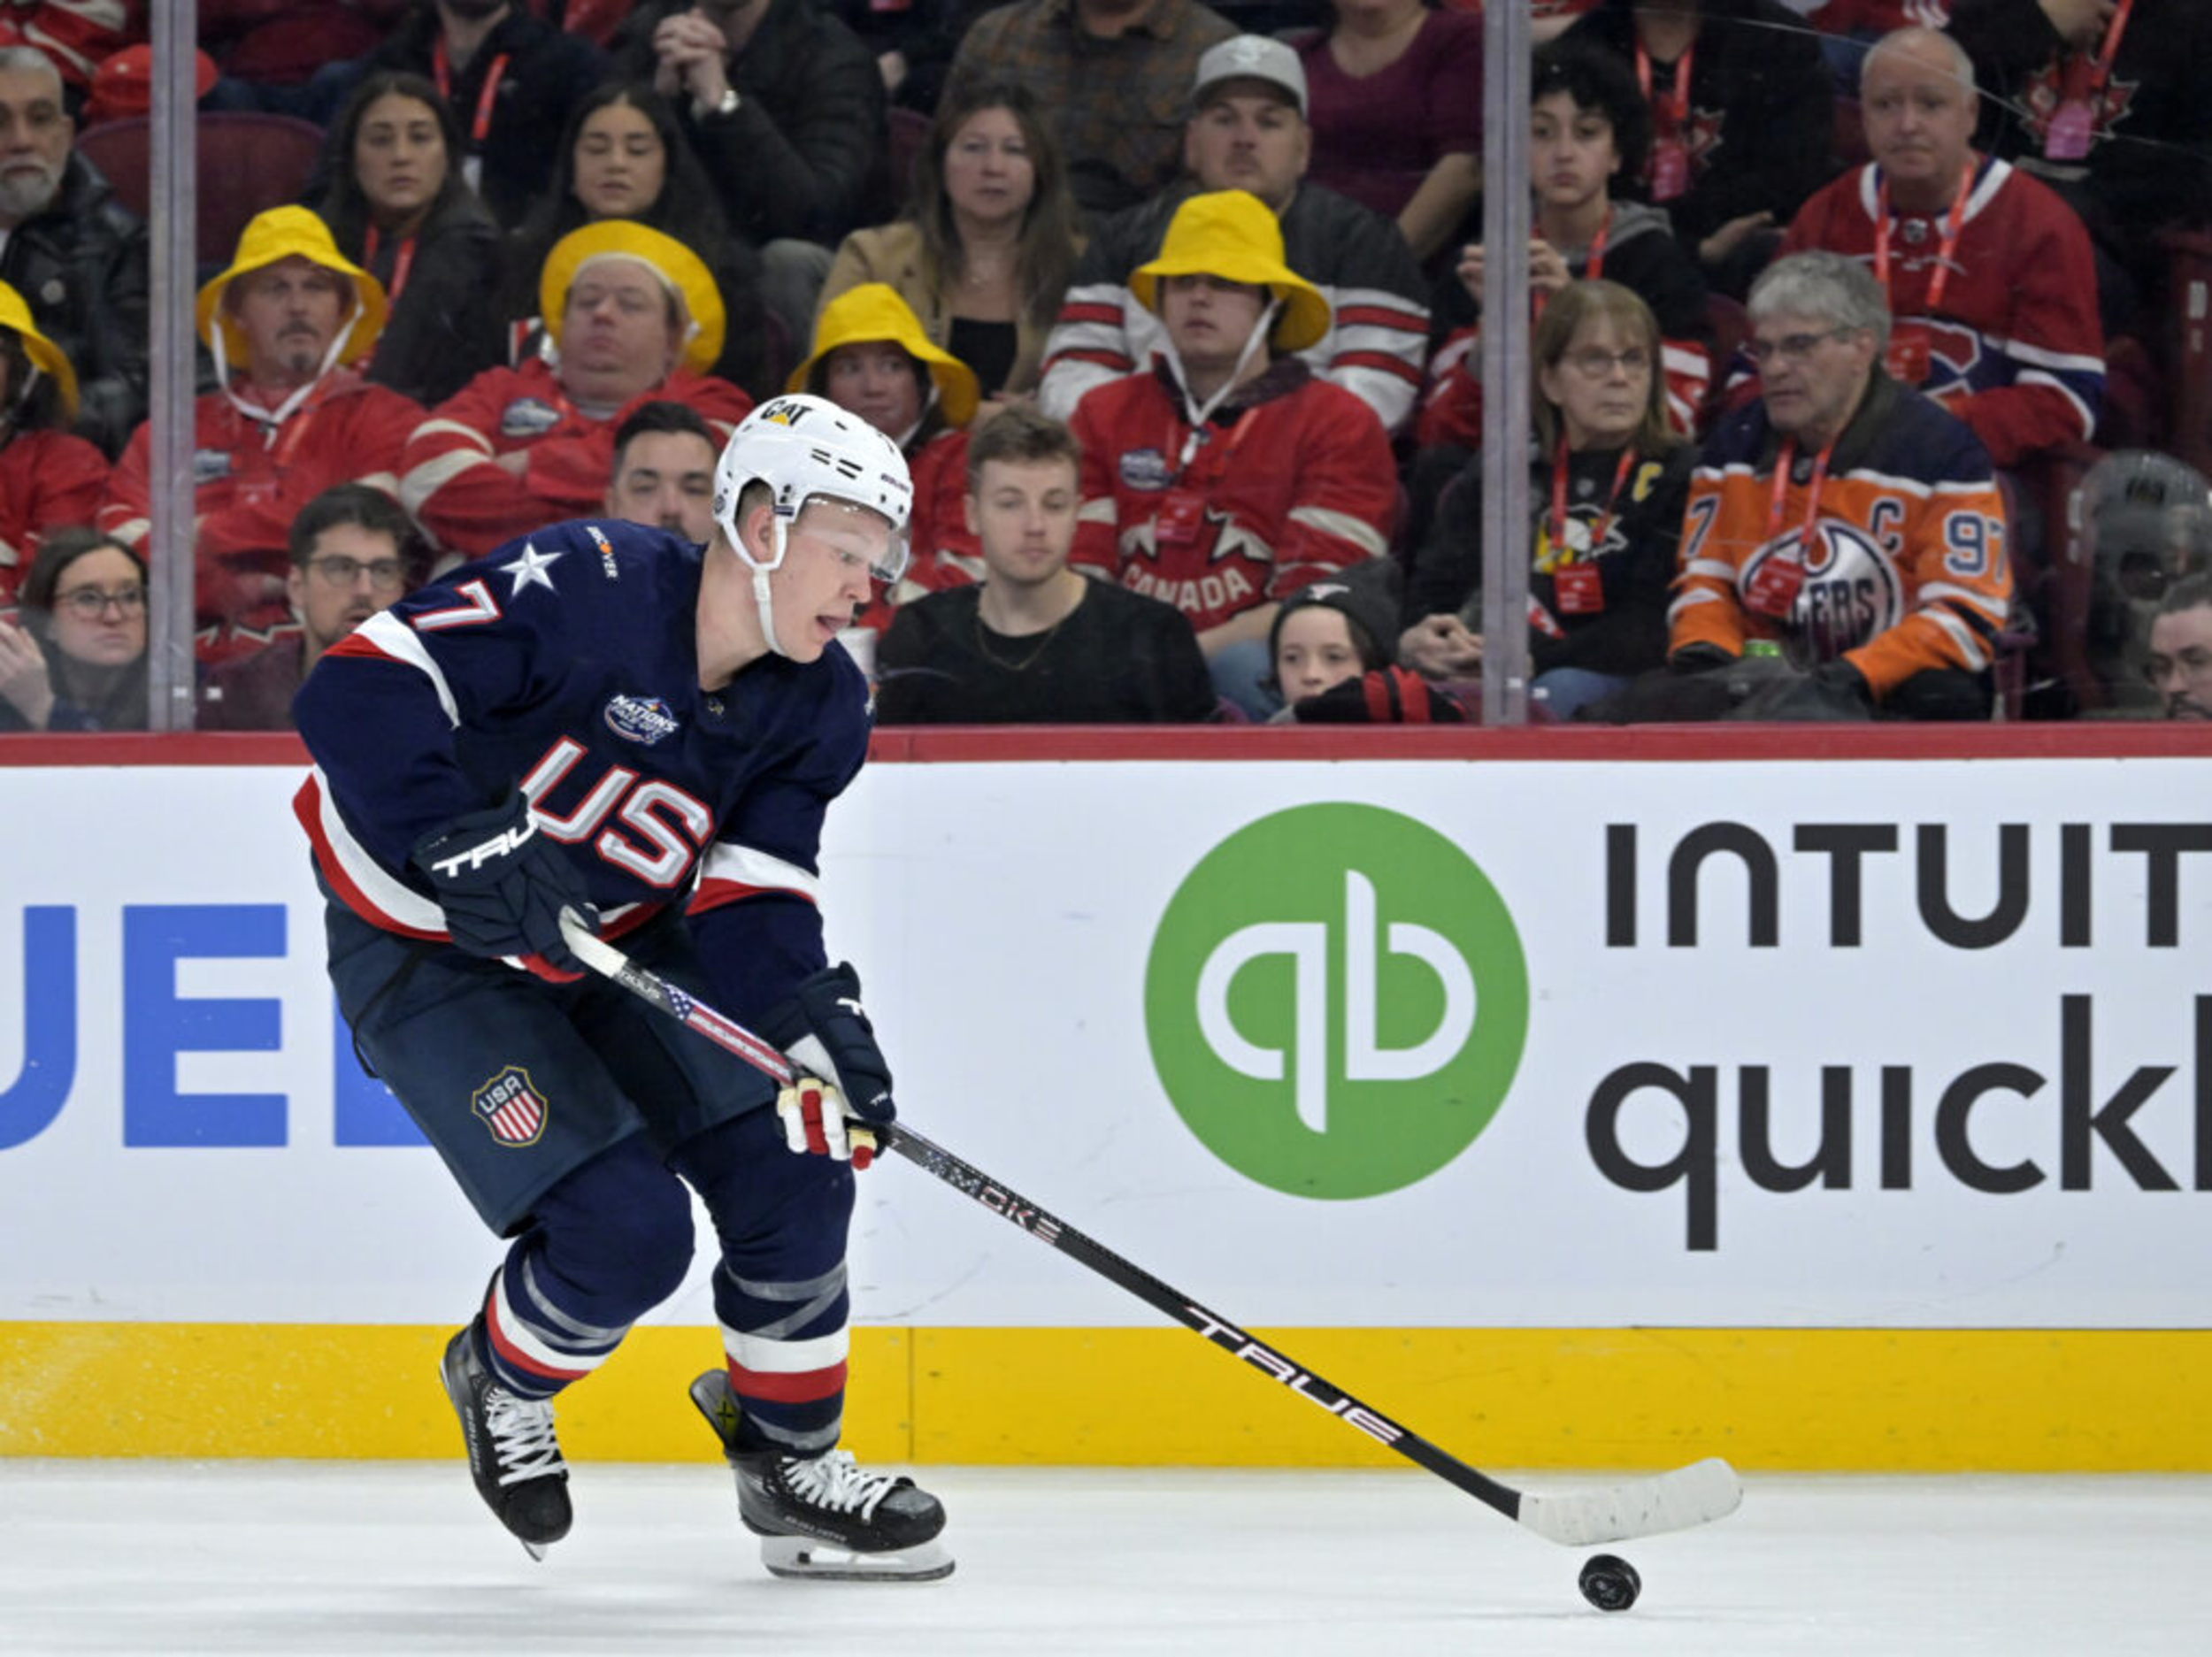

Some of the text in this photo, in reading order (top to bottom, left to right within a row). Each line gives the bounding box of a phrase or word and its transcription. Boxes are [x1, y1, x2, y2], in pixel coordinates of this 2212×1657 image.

[759, 400, 814, 426] CAT
[1870, 496, 1905, 557] C
[407, 577, 502, 631] 7
[1122, 563, 1255, 612] CANADA
[1606, 821, 2212, 950] INTUIT
[478, 1074, 523, 1114] USA
[1184, 1304, 1404, 1446] TRUE
